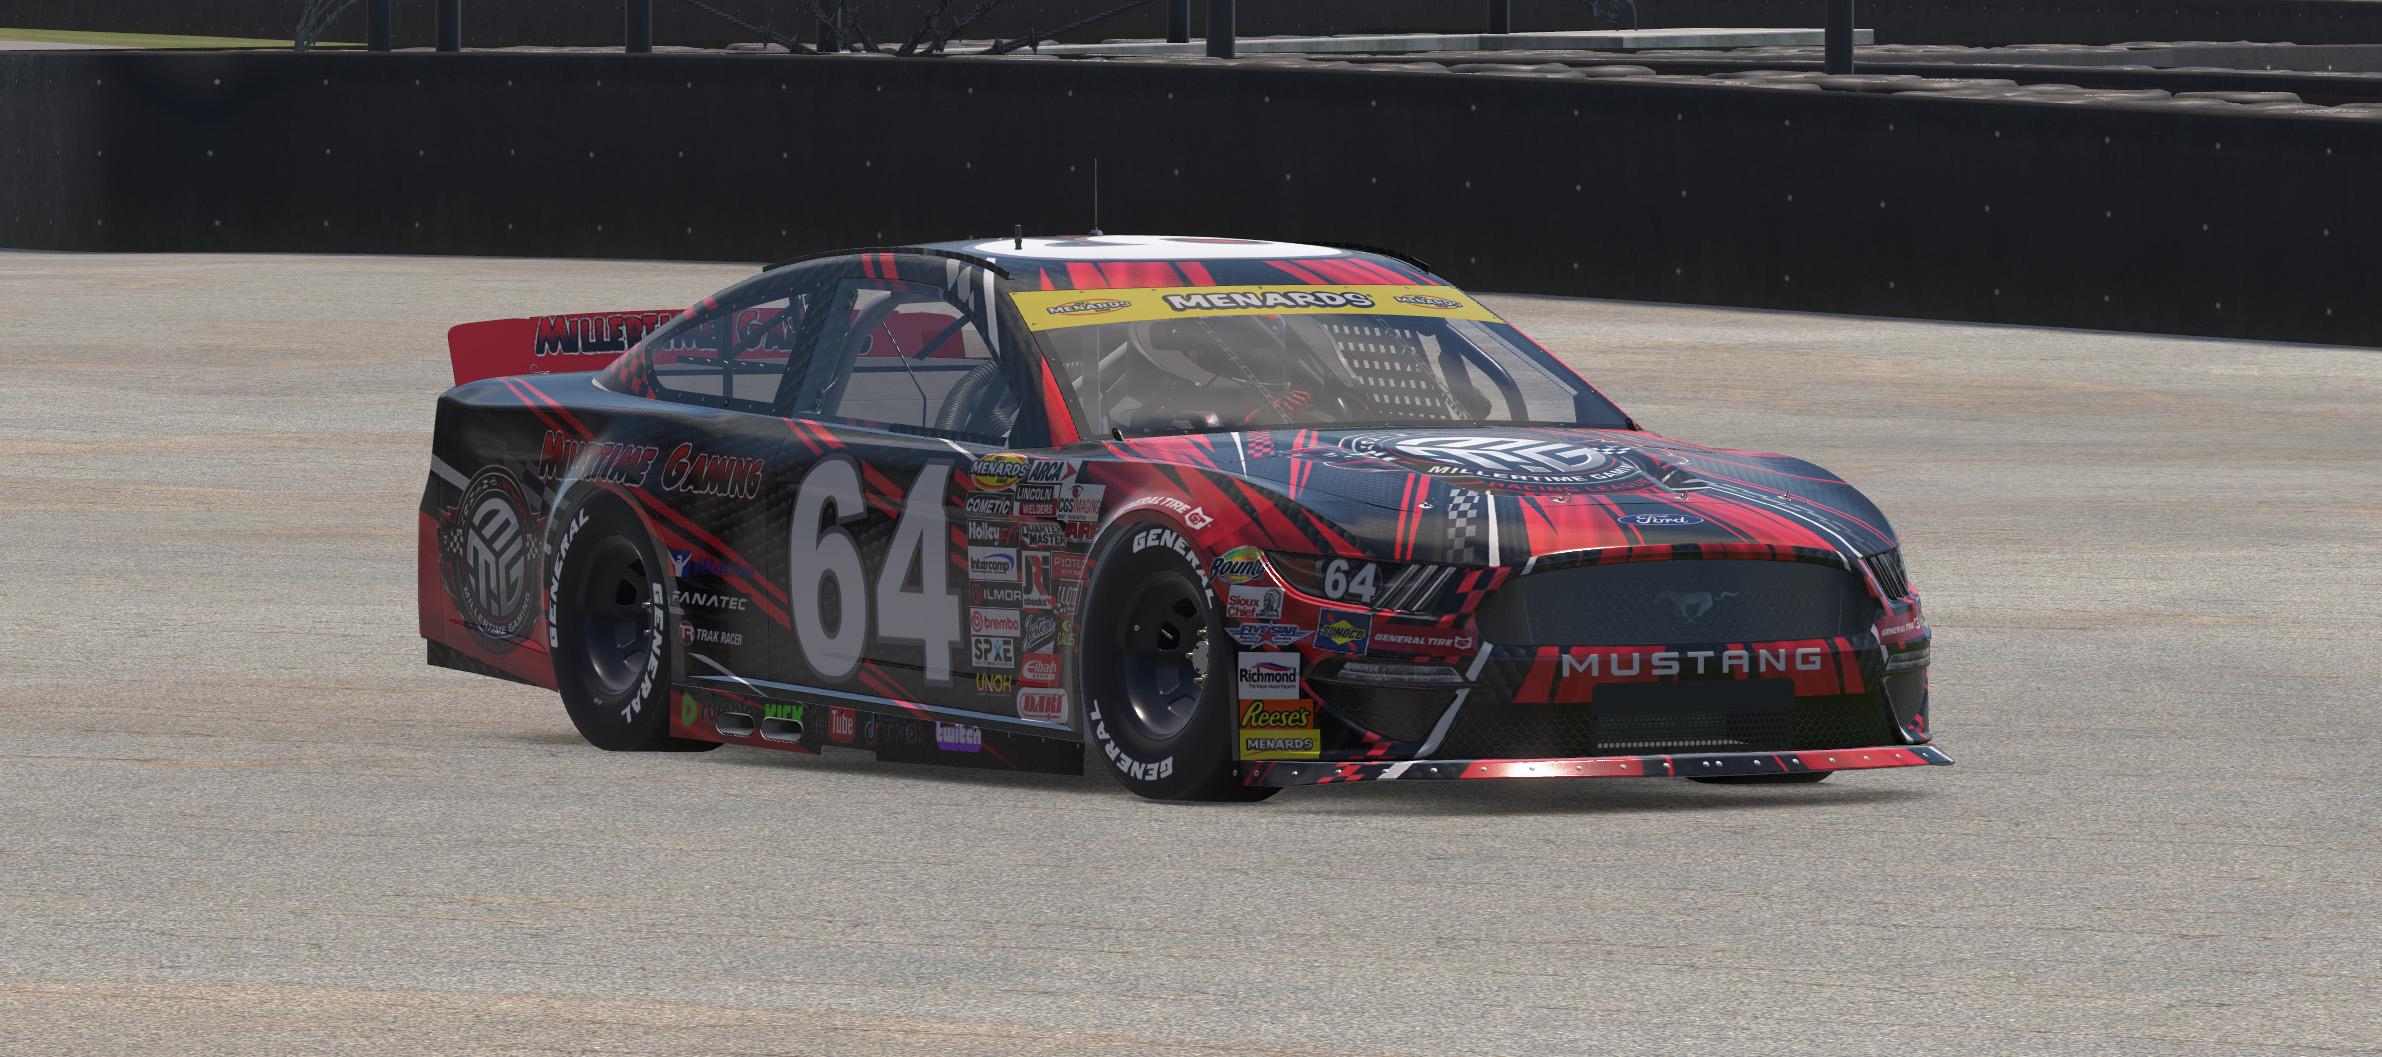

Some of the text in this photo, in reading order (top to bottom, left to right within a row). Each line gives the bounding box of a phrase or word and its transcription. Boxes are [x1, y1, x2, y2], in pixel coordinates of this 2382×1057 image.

[1047, 300, 1132, 315] MENARDS
[1164, 291, 1376, 313] MENARDS
[971, 460, 1029, 477] MENARDS
[1028, 460, 1065, 481] ARCA
[1427, 465, 1588, 483] MILLERTIME
[1016, 487, 1052, 501] LINCOLN
[965, 497, 1011, 515] COMETIC
[1022, 503, 1053, 515] WELDERS
[1635, 515, 1689, 524] Ford
[968, 520, 999, 546] Holley
[787, 453, 963, 688] 64
[970, 555, 1010, 574] Intercomp
[549, 507, 590, 649] GENERAL
[1324, 558, 1378, 603] 64
[671, 590, 749, 612] FANATEC
[983, 589, 1023, 601] ILMOR
[1228, 595, 1260, 607] Sioux
[1227, 606, 1256, 617] Chief
[983, 616, 1019, 631] brembo
[696, 628, 743, 647] TRAK RACER
[1319, 625, 1367, 641] SUNOCO
[1374, 633, 1454, 647] GENERAL TIRE
[620, 582, 664, 725] GENERAL
[1561, 647, 1822, 678] MUSTANG
[976, 671, 1012, 693] UNOH
[1240, 668, 1297, 683] Richmond
[1241, 700, 1310, 728] Reese's
[935, 719, 982, 745] twitch
[1087, 699, 1174, 781] GENERAL
[1246, 737, 1314, 752] MENARDS
